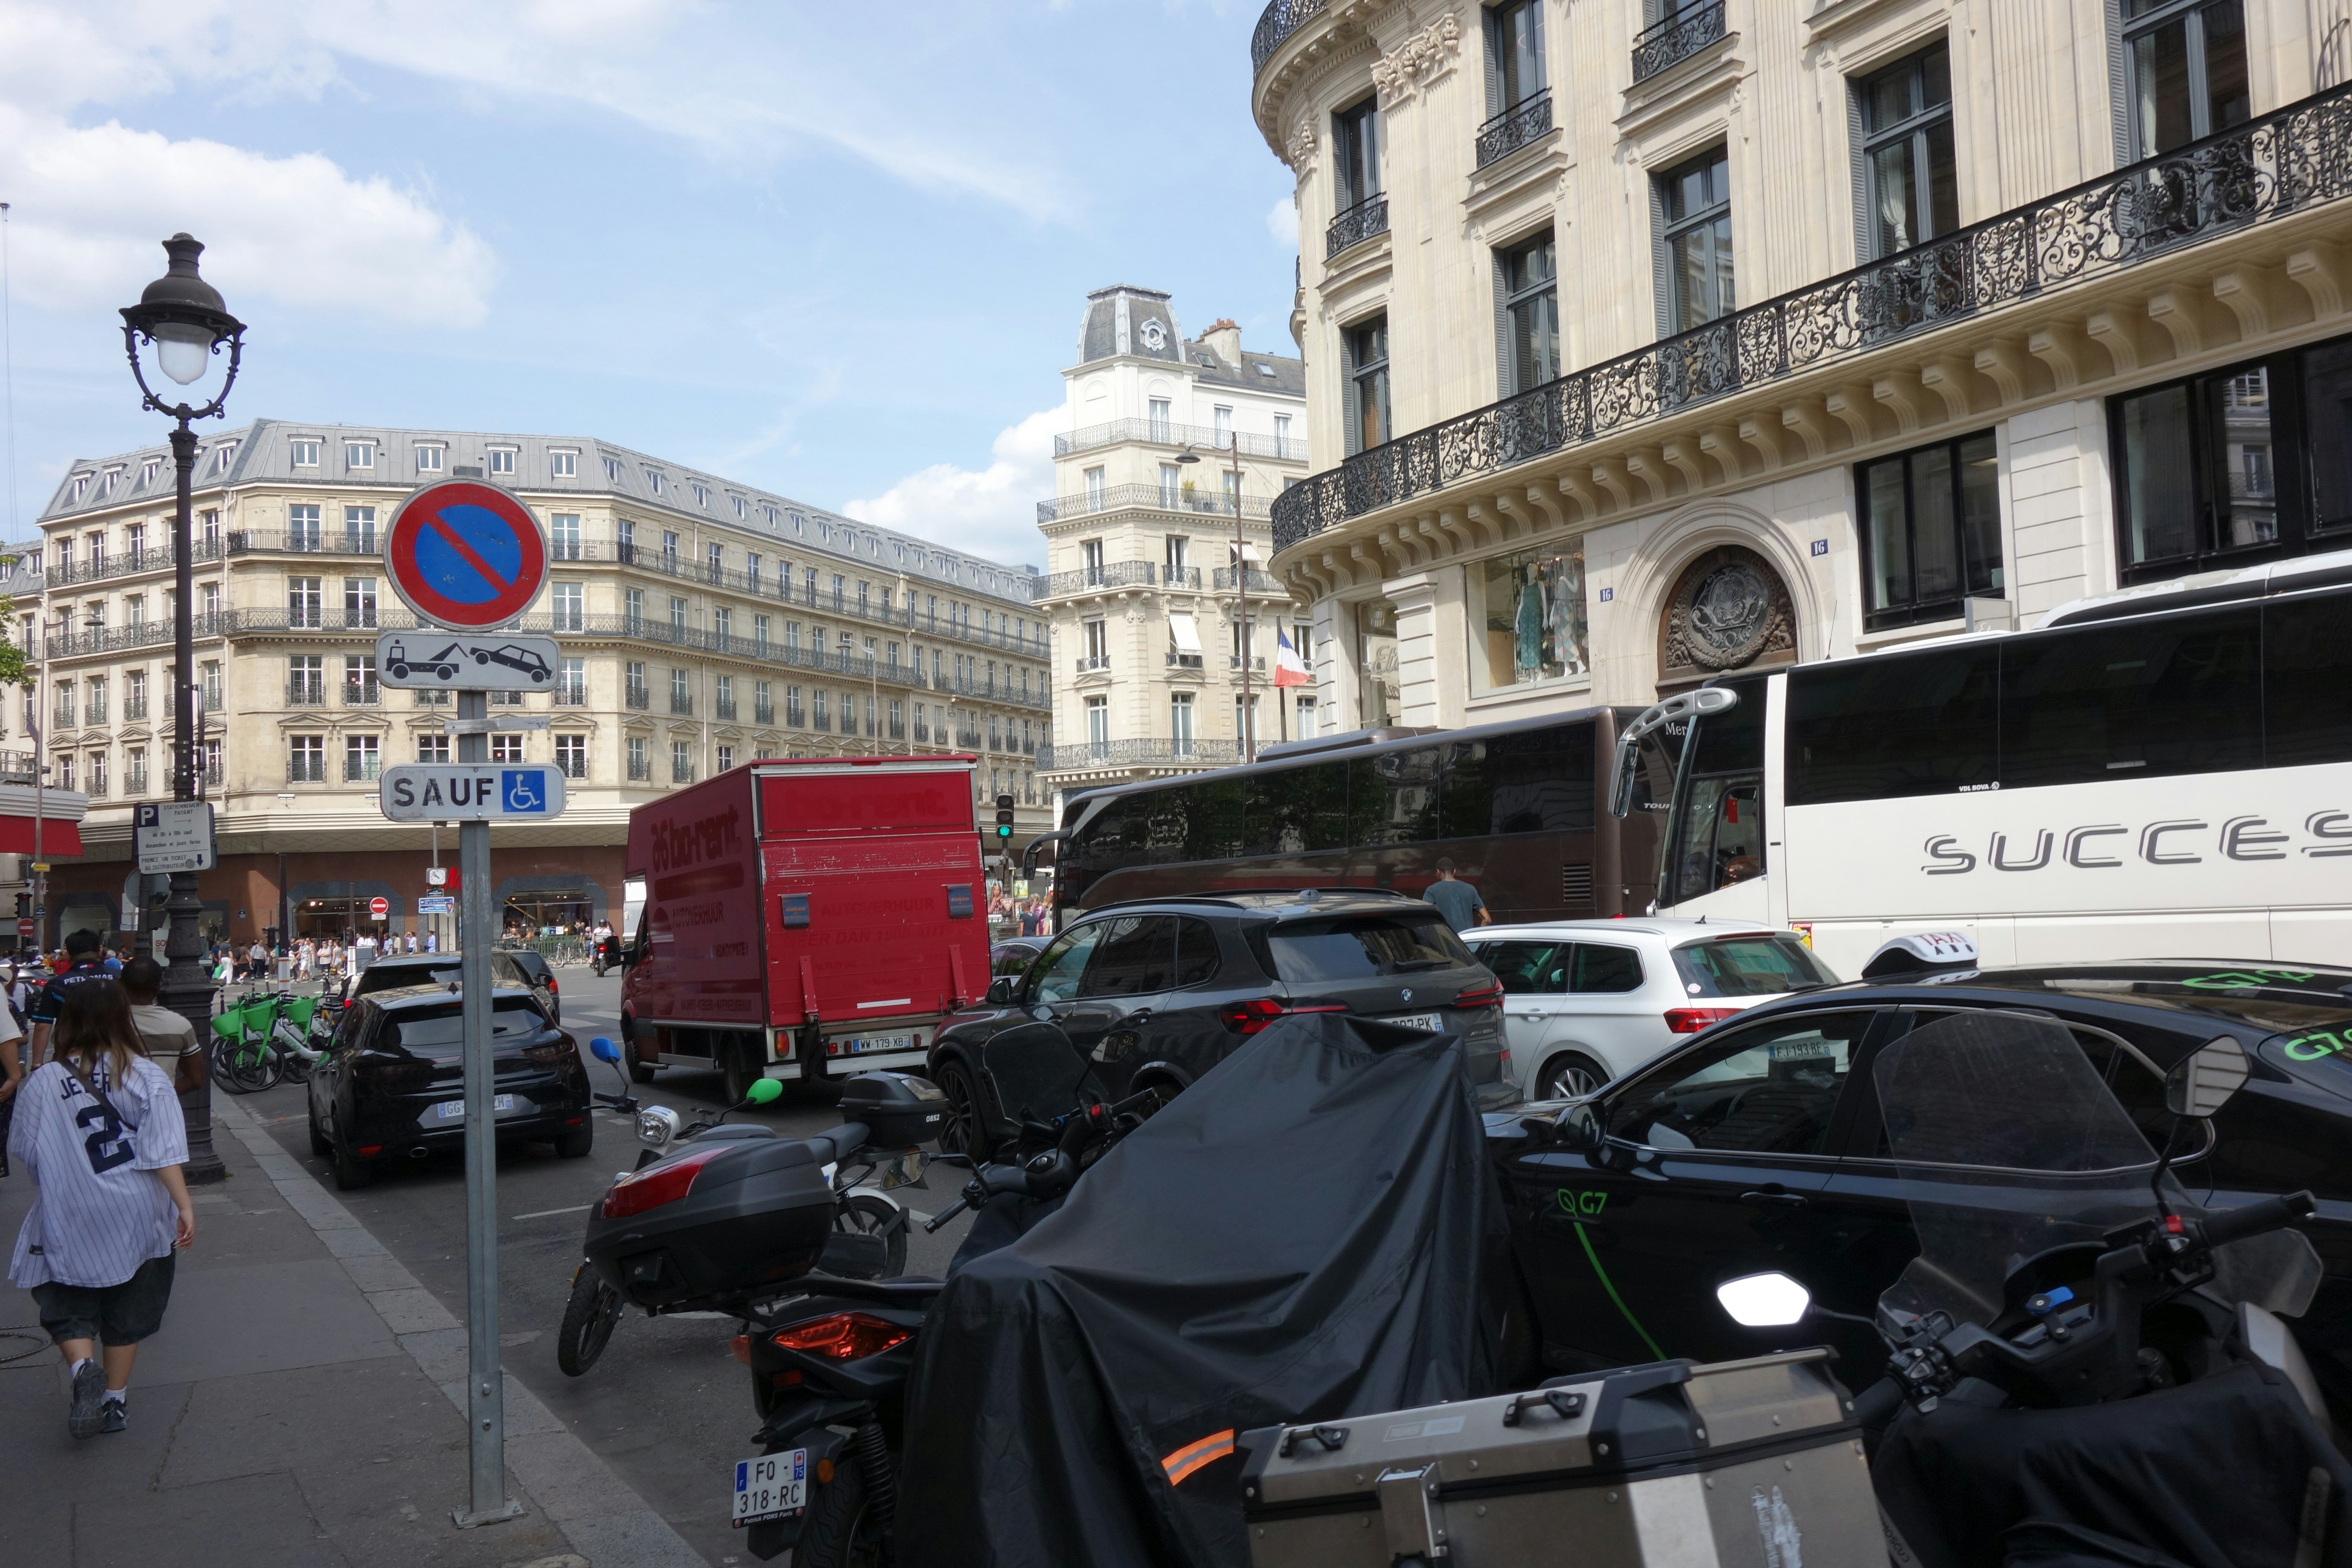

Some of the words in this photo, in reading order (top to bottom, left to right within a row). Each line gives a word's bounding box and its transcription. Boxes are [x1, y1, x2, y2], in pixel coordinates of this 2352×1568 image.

[1814, 541, 1826, 555] 16
[1602, 590, 1611, 600] 16
[394, 778, 493, 807] SAUF
[141, 807, 154, 825] P
[1921, 810, 2352, 875] SUCCES
[1914, 932, 1967, 946] TAXI
[2180, 972, 2270, 989] G7
[2285, 1032, 2344, 1061] G7
[60, 1073, 111, 1100] JEER
[926, 1114, 940, 1122] 0852
[76, 1104, 135, 1174] 2
[1580, 1191, 1608, 1214] G7
[795, 1467, 804, 1478] 75
[740, 1483, 800, 1513] 318-RC
[763, 1512, 778, 1521] PONS
[779, 1510, 793, 1518] Paris
